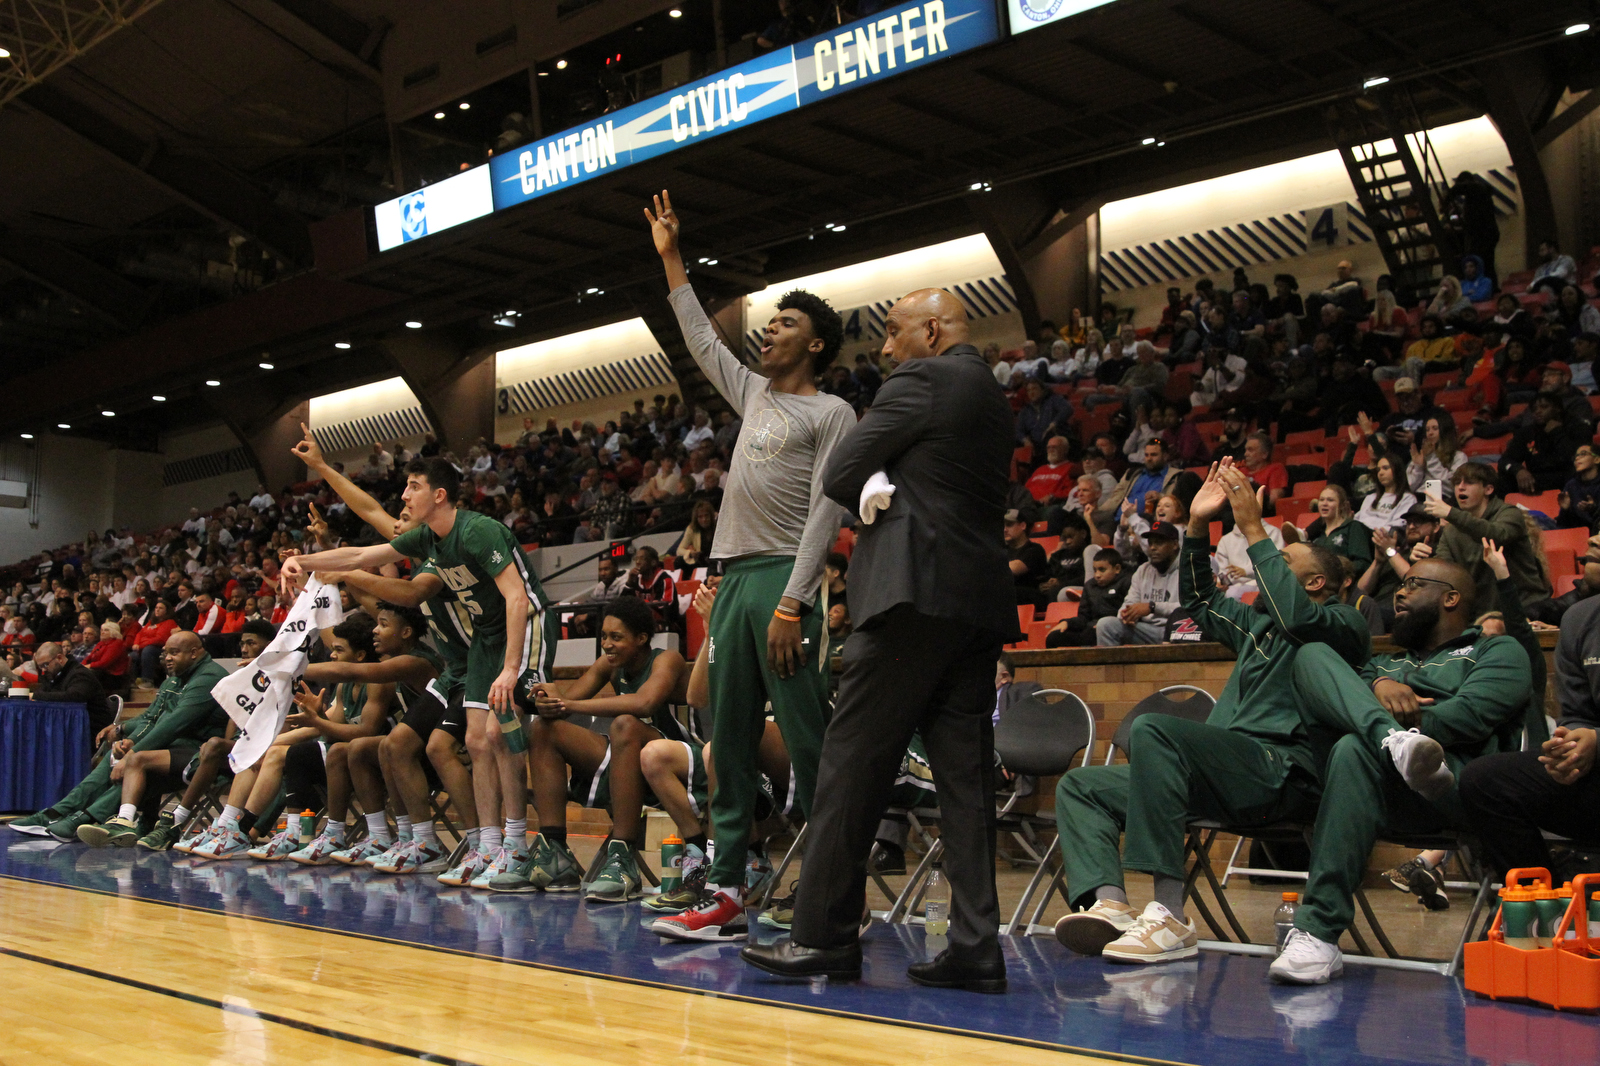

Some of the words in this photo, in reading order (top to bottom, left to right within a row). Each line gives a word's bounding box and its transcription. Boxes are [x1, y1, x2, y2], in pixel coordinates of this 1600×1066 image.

[519, 120, 617, 195] CANTON
[669, 72, 748, 142] CIVIC
[813, 0, 948, 92] CENTER
[1311, 207, 1339, 246] 4
[845, 309, 863, 340] 4
[498, 388, 509, 414] 3
[1152, 521, 1161, 530] C
